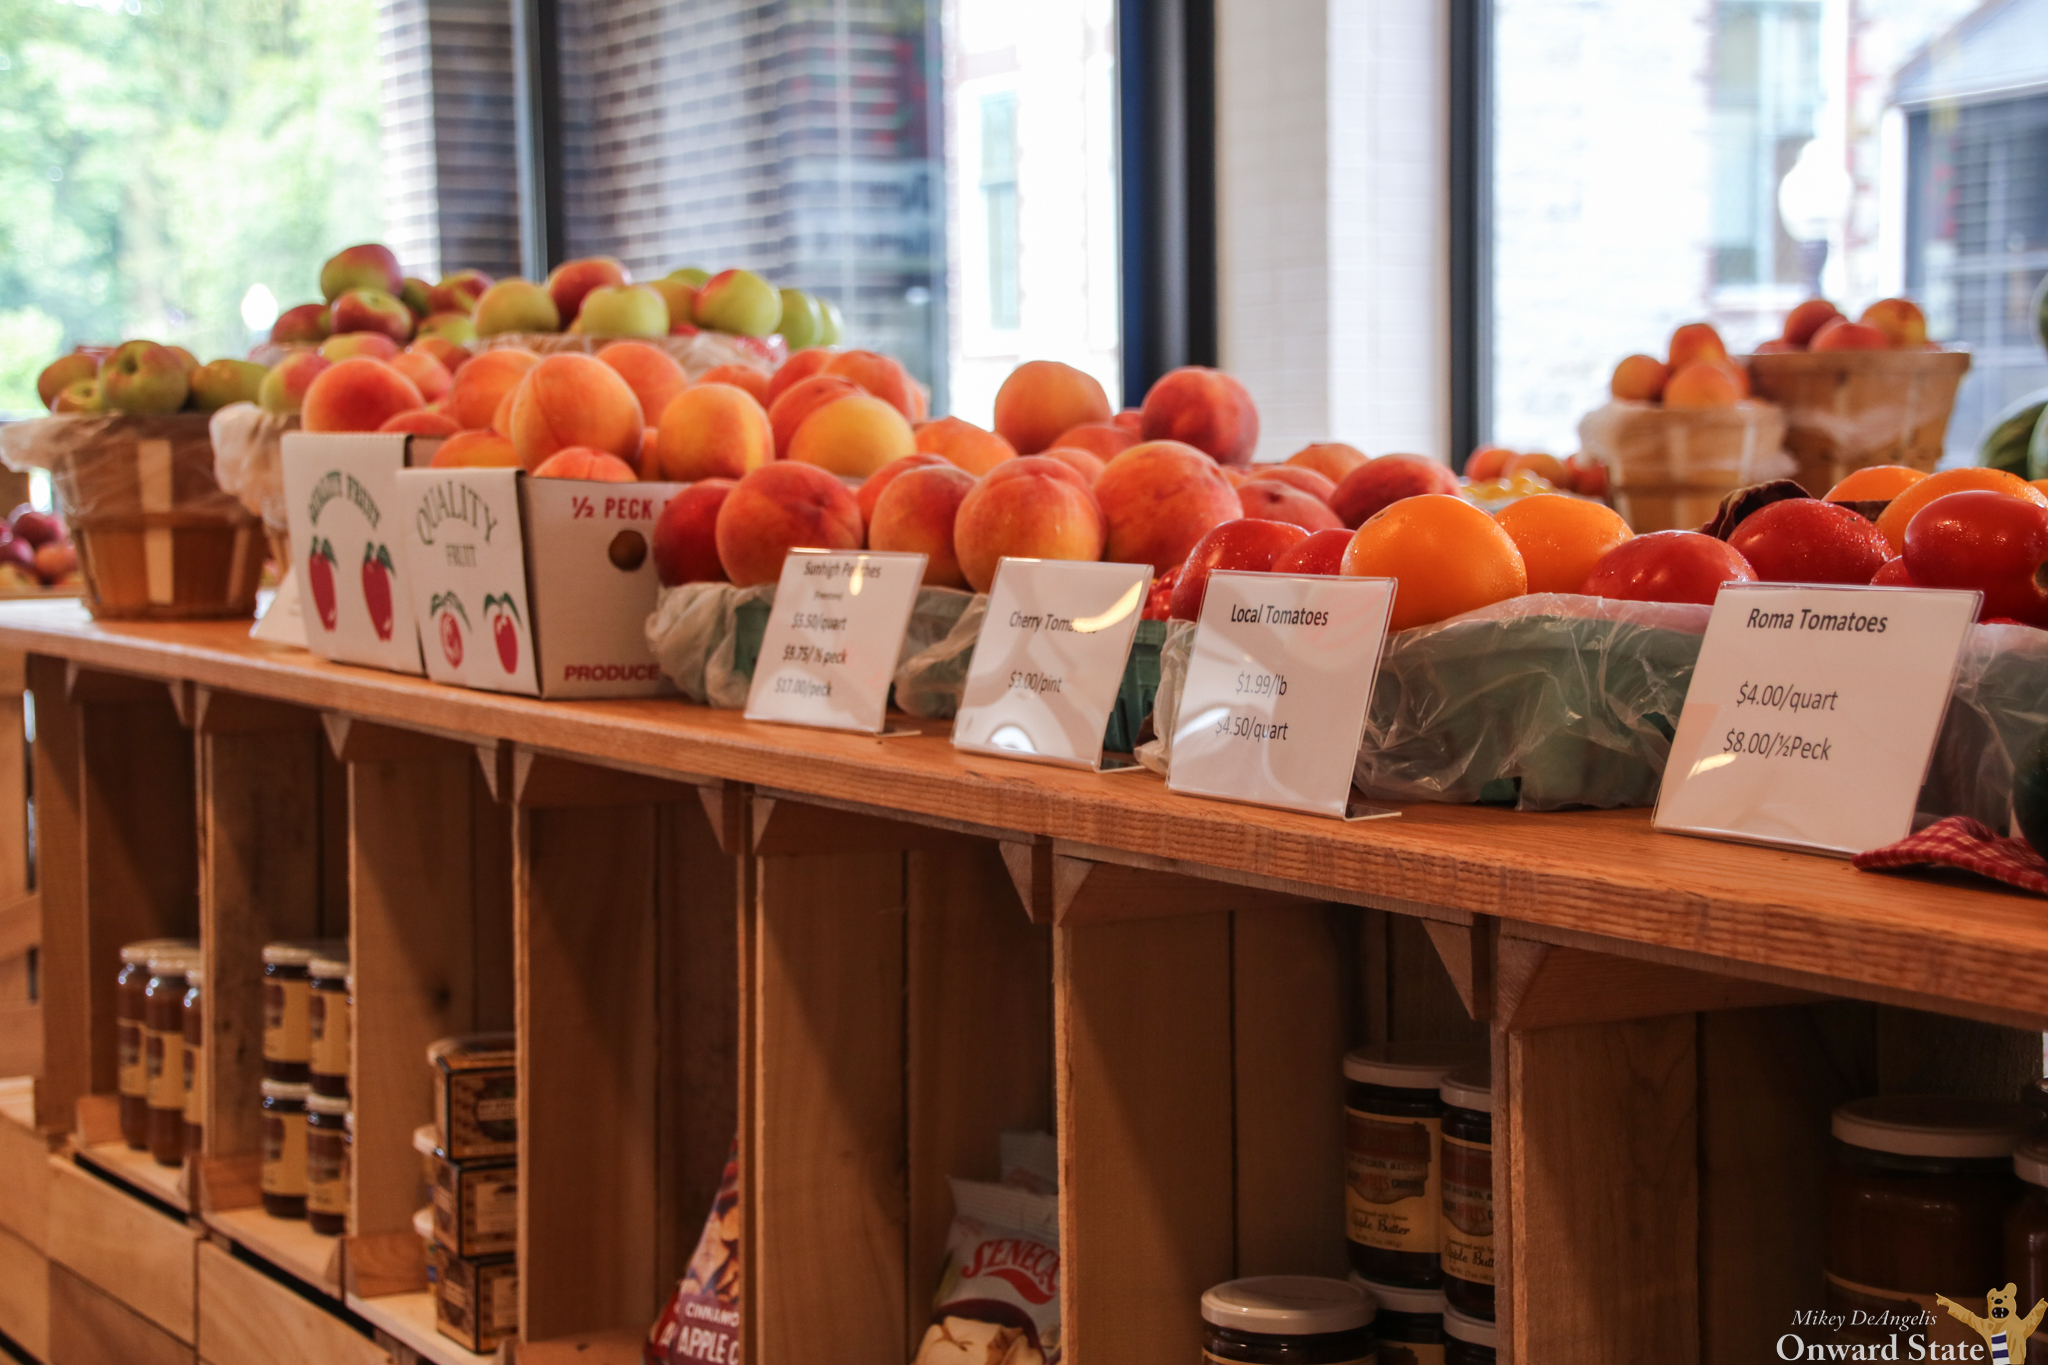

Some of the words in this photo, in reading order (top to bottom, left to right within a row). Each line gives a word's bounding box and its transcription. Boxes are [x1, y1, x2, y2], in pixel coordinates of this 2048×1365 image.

[416, 480, 498, 544] QUALITY
[604, 497, 653, 520] PECK
[791, 611, 847, 631] $5.50/quart
[1009, 610, 1043, 633] Cherry
[1231, 603, 1264, 624] Local
[1265, 604, 1329, 626] Tomatoes
[1746, 607, 1795, 629] Roma
[1799, 608, 1888, 633] Tomatoes
[564, 663, 661, 681] PRODUCE
[1008, 669, 1062, 694] $3.00/pint
[1236, 670, 1287, 698] $1.99/lb
[1736, 680, 1838, 714] $4.00/quart
[1215, 715, 1289, 742] $4.50/quart
[1377, 1217, 1410, 1236] Butter
[961, 1238, 1060, 1294] SENECA
[677, 1324, 729, 1364] APPLE
